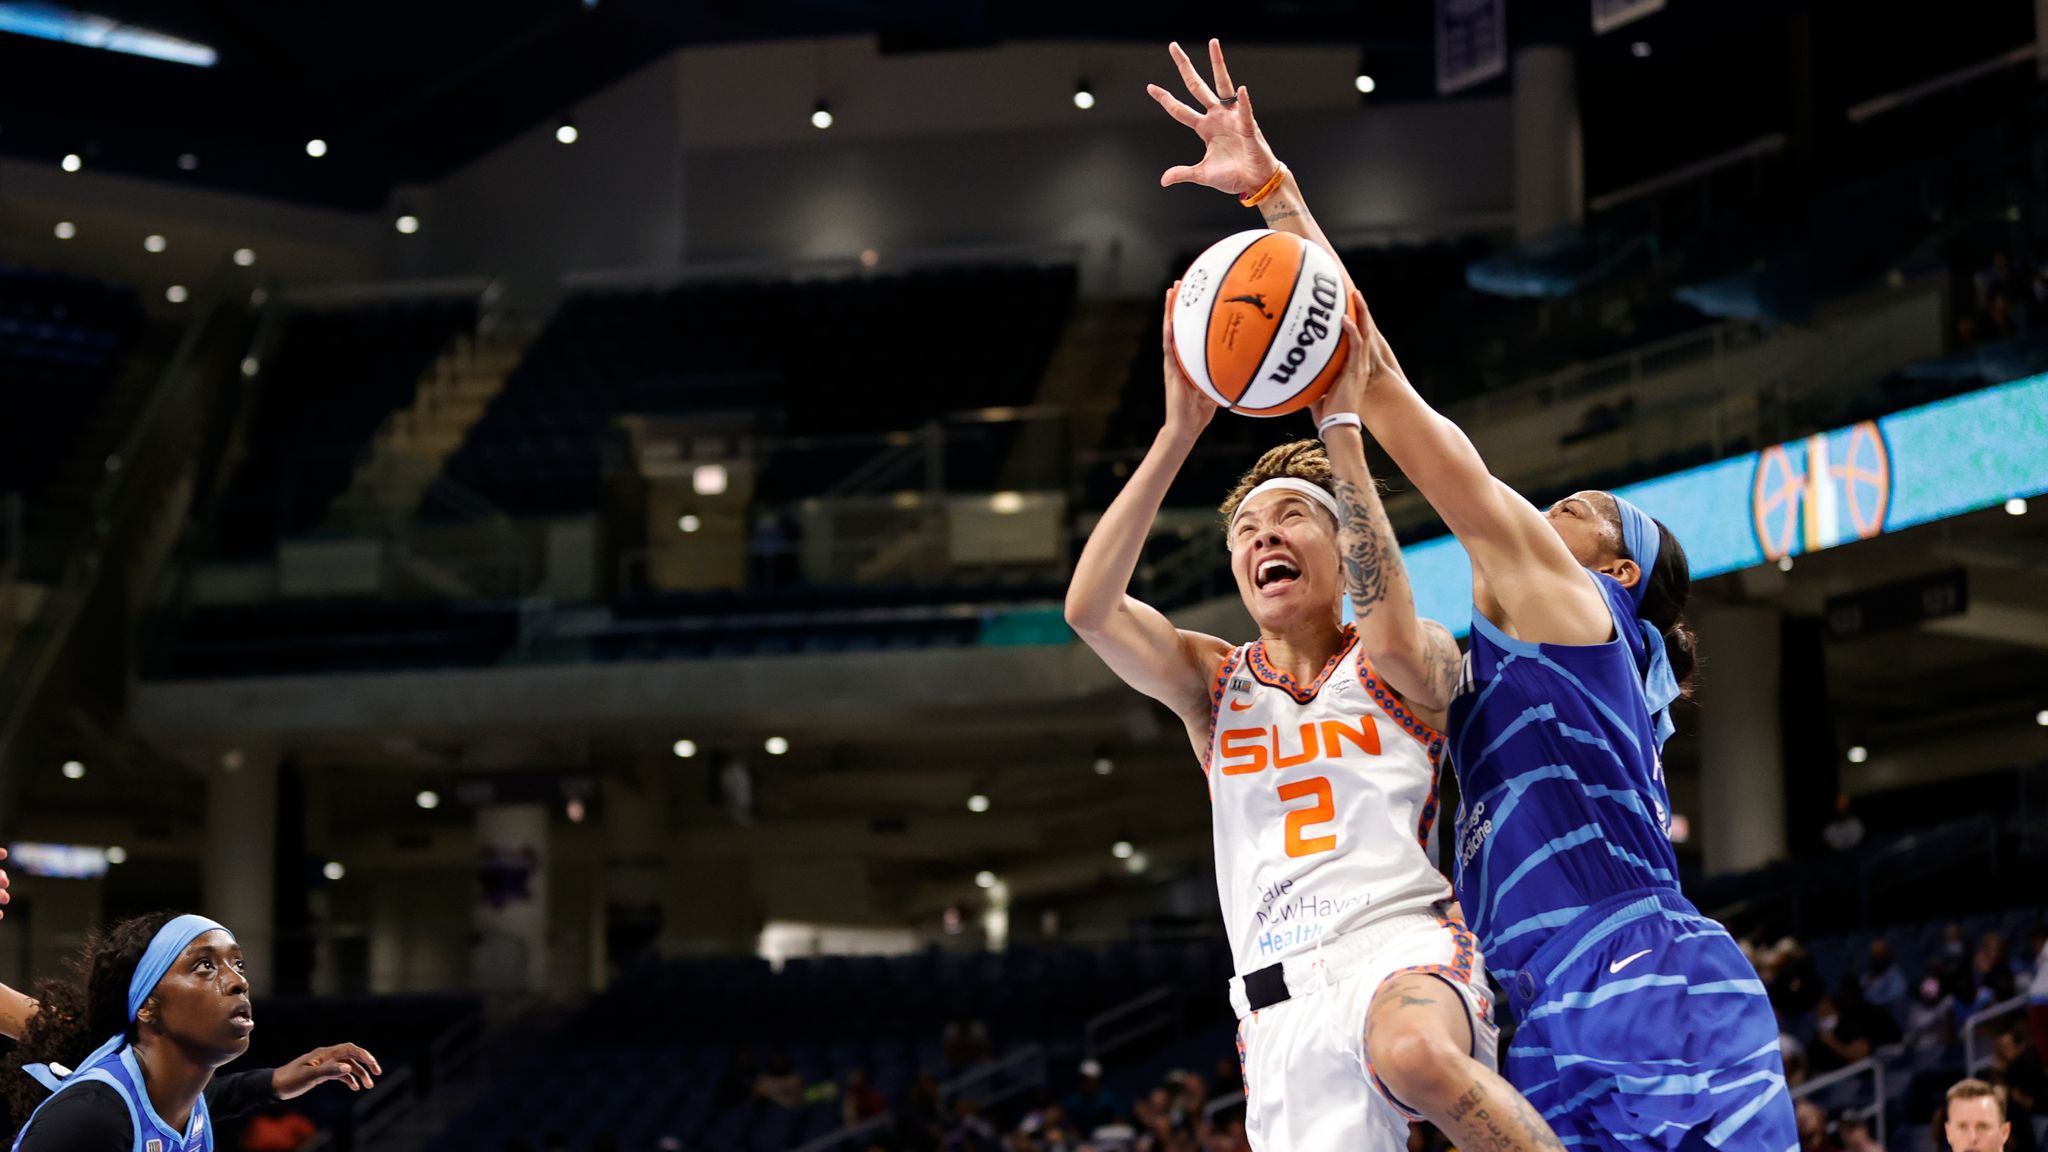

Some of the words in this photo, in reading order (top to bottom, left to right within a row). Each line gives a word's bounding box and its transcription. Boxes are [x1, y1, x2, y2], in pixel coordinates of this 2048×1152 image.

[1268, 272, 1338, 385] Wilson
[1220, 714, 1382, 777] SUN
[1277, 776, 1337, 858] 2
[1462, 819, 1493, 870] edicine
[1257, 879, 1293, 903] ale
[1258, 923, 1322, 957] Health
